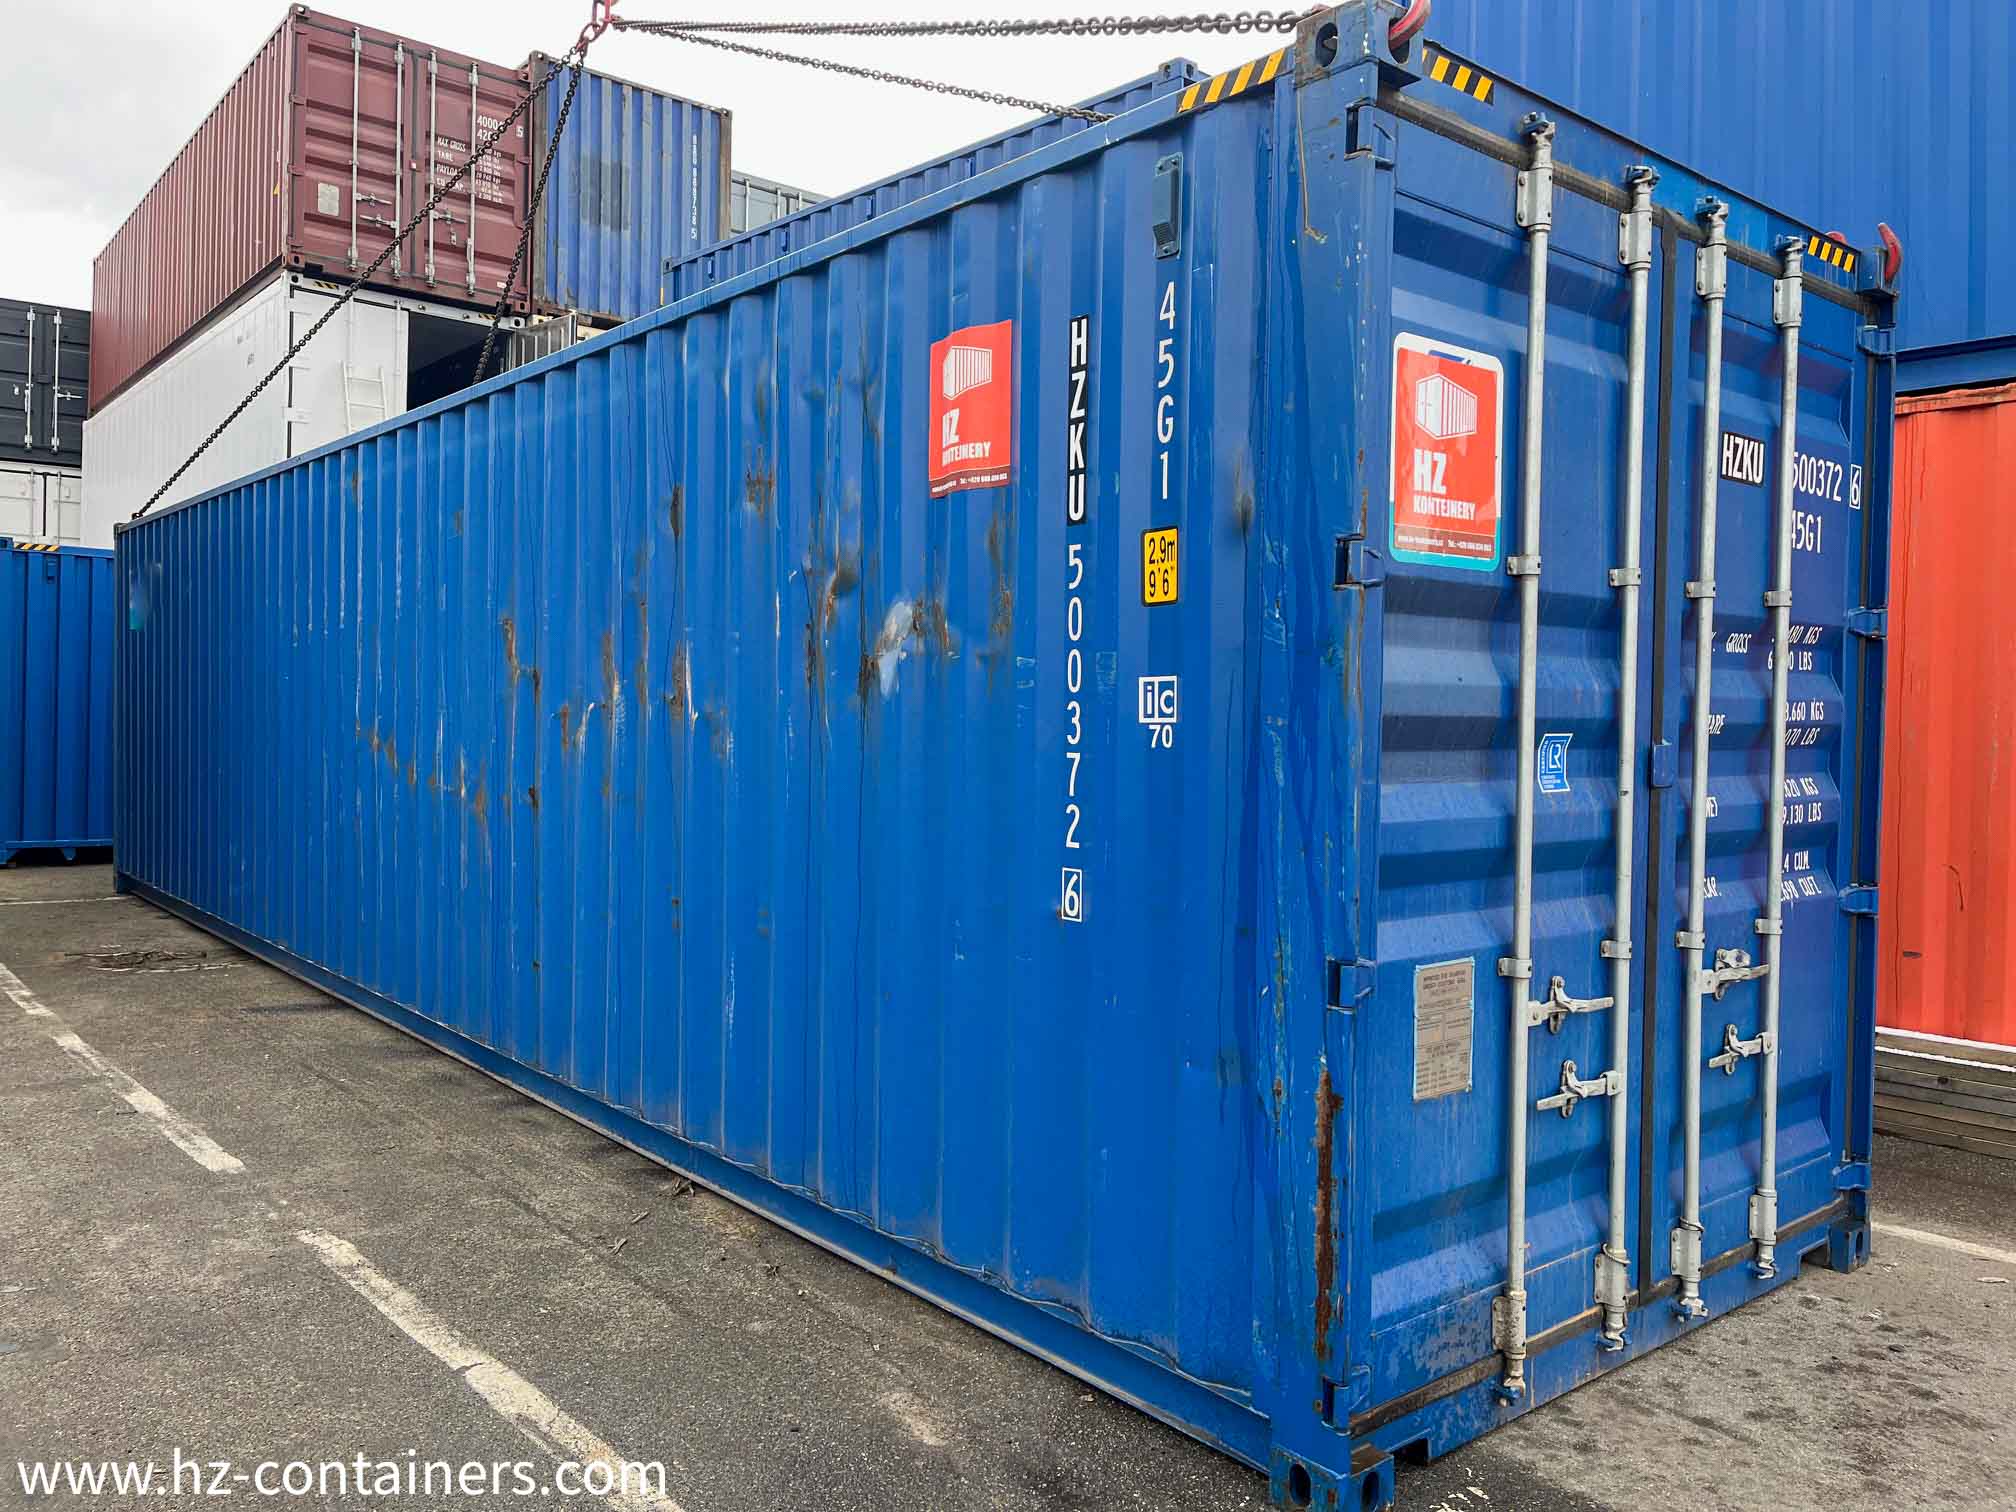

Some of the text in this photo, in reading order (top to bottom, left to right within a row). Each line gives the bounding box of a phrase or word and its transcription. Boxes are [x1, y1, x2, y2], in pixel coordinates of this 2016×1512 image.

[436, 164, 460, 176] PAYLOA
[1156, 280, 1176, 500] 45G1
[1413, 447, 1447, 495] HZ
[1721, 432, 1765, 484] HZKU
[1850, 466, 1860, 508] 6
[1413, 495, 1476, 521] KONTEJNERY
[1148, 535, 1176, 565] 2.9m
[1063, 318, 1088, 920] HZKU 500372 6
[1726, 632, 1752, 654] GROSS
[1803, 625, 1823, 645] KGS
[1798, 651, 1813, 671] LBS
[1810, 699, 1824, 721] KGS
[1149, 724, 1173, 749] 70
[1800, 727, 1821, 746] LBS
[1782, 802, 1822, 825] 9.130 LBS
